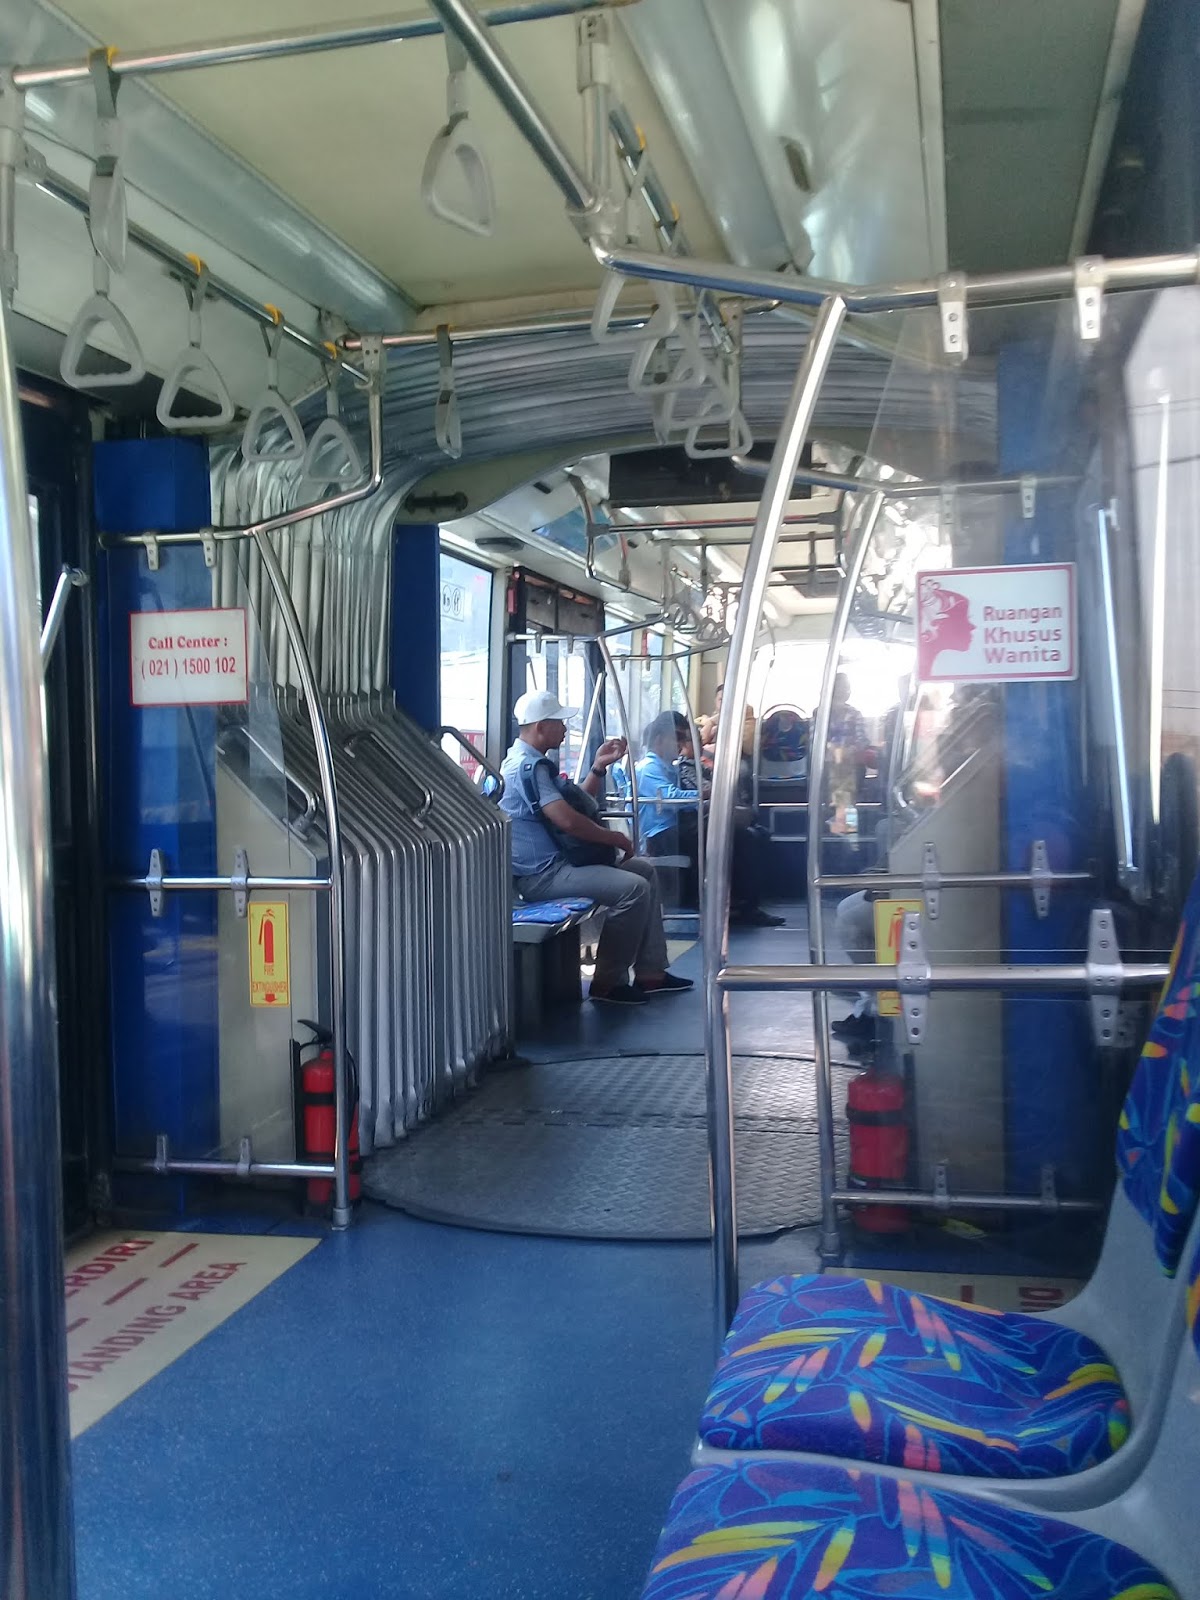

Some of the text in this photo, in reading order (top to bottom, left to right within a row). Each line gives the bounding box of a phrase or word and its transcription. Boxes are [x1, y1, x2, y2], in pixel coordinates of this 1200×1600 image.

[983, 606, 1062, 623] Ruangan
[148, 636, 173, 649] Call
[984, 627, 1062, 644] Khusus
[984, 646, 1061, 663] Wanita
[183, 658, 210, 675] 1500
[215, 657, 236, 674] 102
[264, 965, 275, 976] FIRE
[167, 1262, 248, 1301] AREA
